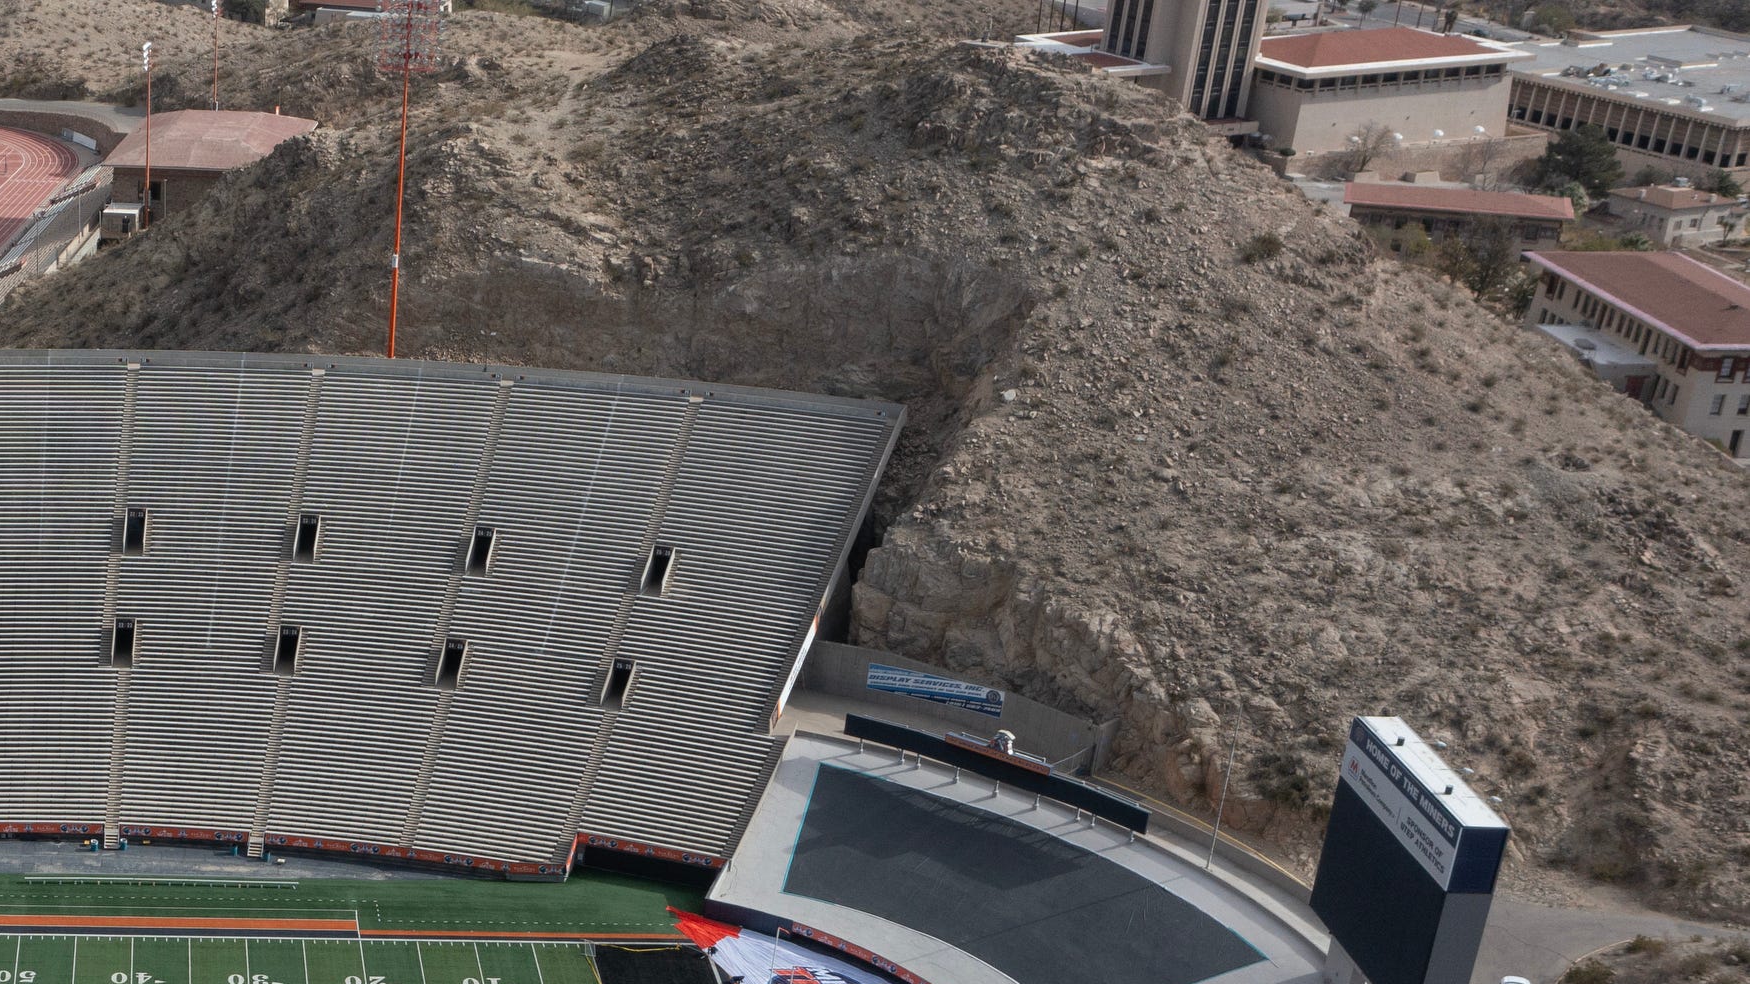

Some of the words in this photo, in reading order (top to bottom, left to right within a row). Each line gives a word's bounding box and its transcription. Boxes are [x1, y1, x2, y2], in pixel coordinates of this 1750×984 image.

[868, 674, 911, 684] DISPLAY
[1365, 738, 1390, 770] HOME
[1390, 764, 1403, 780] OF
[1403, 776, 1420, 801] THE
[1419, 794, 1455, 839] MINERS
[1400, 821, 1415, 840] UTEP
[1414, 839, 1445, 874] ATHLETICS
[1406, 816, 1434, 850] SPONSOR
[111, 972, 153, 984] 40
